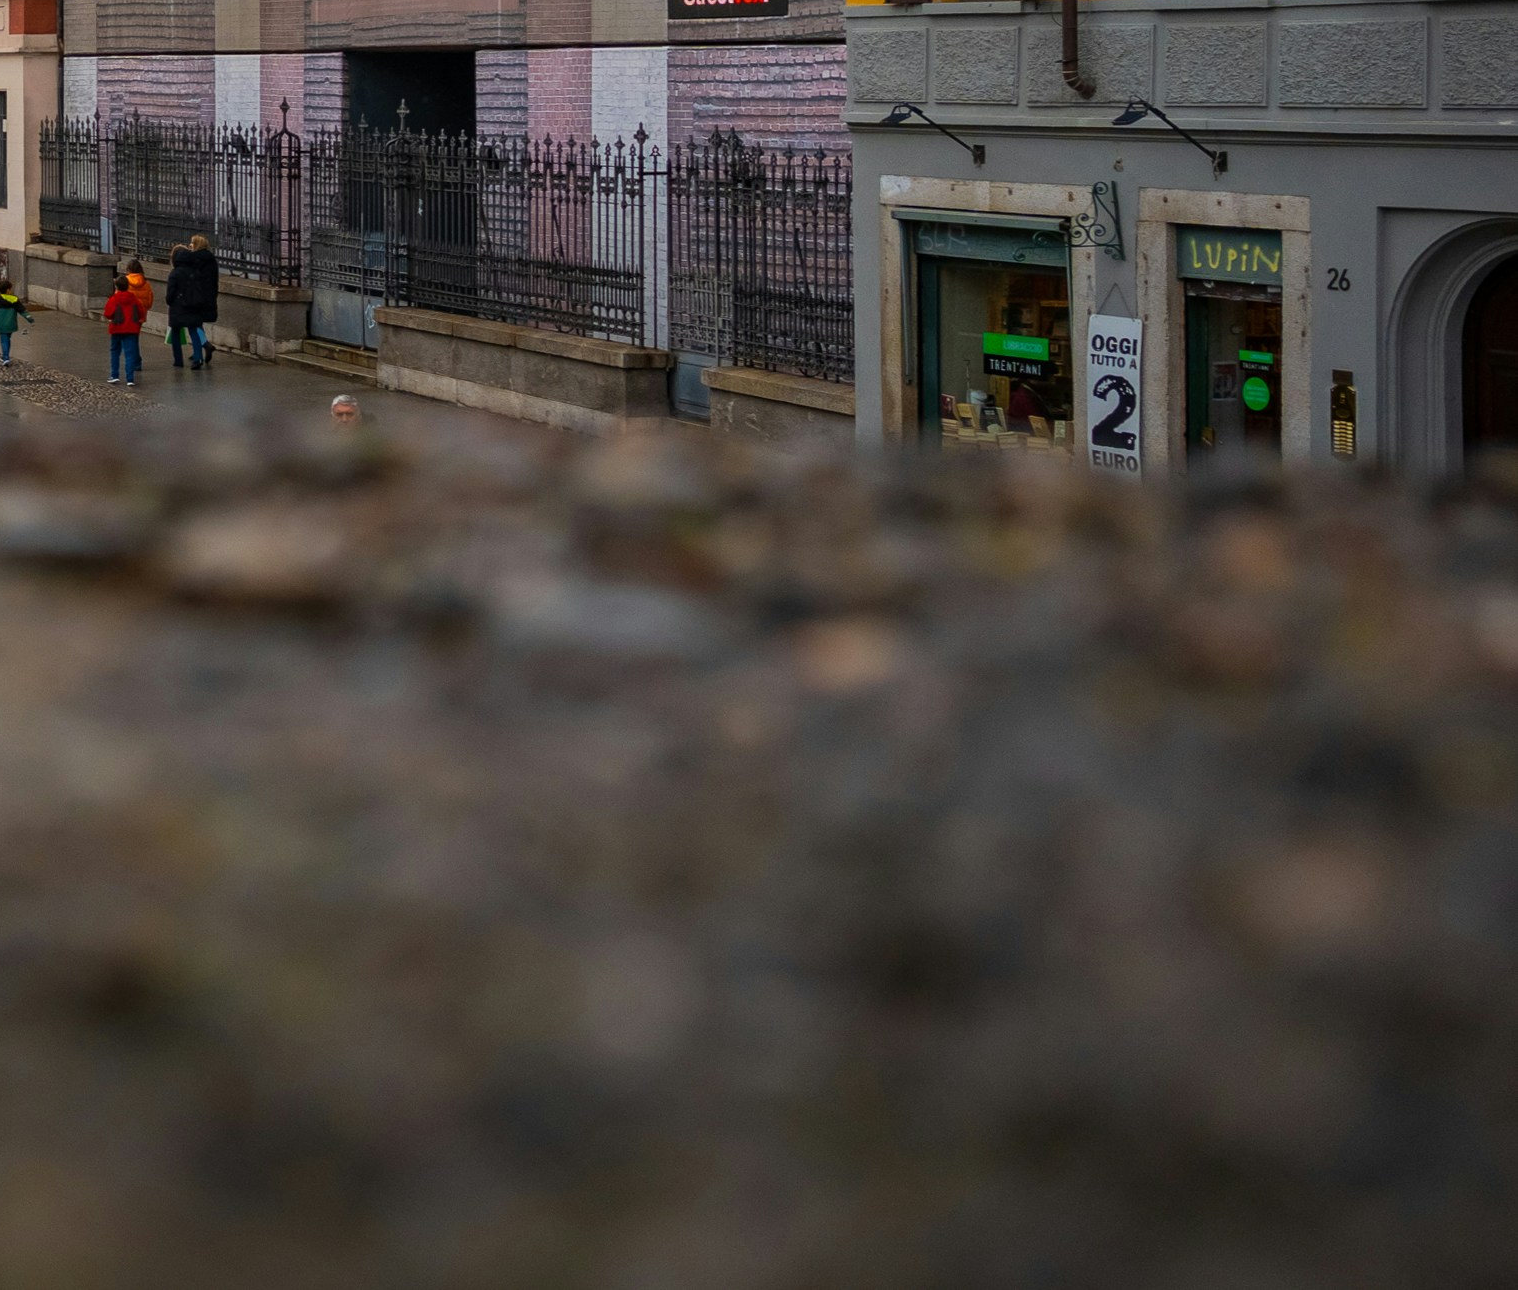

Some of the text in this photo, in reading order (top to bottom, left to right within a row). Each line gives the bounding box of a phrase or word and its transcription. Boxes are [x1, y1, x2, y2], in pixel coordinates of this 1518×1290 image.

[1327, 267, 1351, 292] 26
[1003, 339, 1043, 354] LIBRACCIO
[1091, 334, 1138, 356] OGGI
[989, 358, 1042, 376] TRENT'ANNI
[1090, 353, 1137, 370] TUTTO A
[1092, 374, 1137, 451] 2
[1091, 450, 1139, 473] EURO
